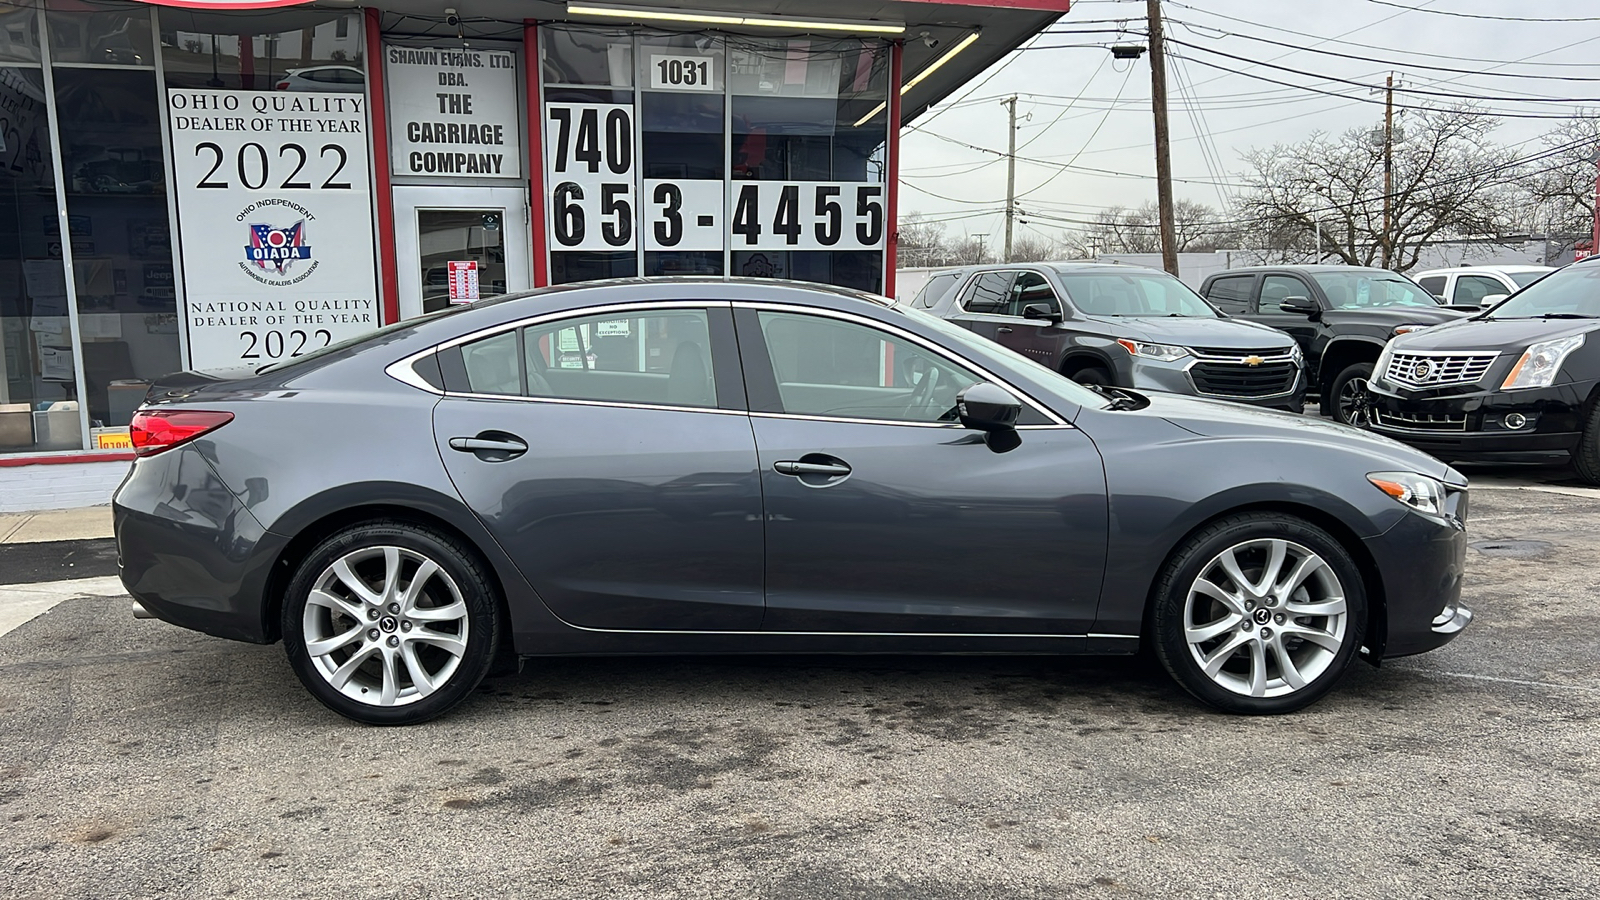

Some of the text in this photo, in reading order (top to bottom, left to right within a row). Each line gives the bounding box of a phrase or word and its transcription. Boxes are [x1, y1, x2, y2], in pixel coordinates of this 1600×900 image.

[390, 50, 437, 66] SHAWN
[489, 54, 514, 69] LTD.
[438, 72, 468, 87] DBA.
[657, 59, 708, 86] 1031
[171, 94, 362, 114] OHIO QUALITY
[436, 93, 473, 115] THE
[175, 117, 362, 133] DEALER OF THE YEAR
[407, 121, 504, 145] CARRIAGE
[550, 107, 631, 175] 740
[195, 142, 352, 190] 2022
[409, 151, 504, 174] COMPANY
[236, 198, 316, 222] OHIO INDEPENDENT
[253, 247, 301, 260] OIADA
[146, 270, 173, 281] Jeep
[238, 260, 320, 287] AUTOMOBILE DEALERS ASSOCIATION
[191, 300, 372, 313] NATIONAL QUALITY
[194, 313, 371, 327] DEALER OF THE YEAR
